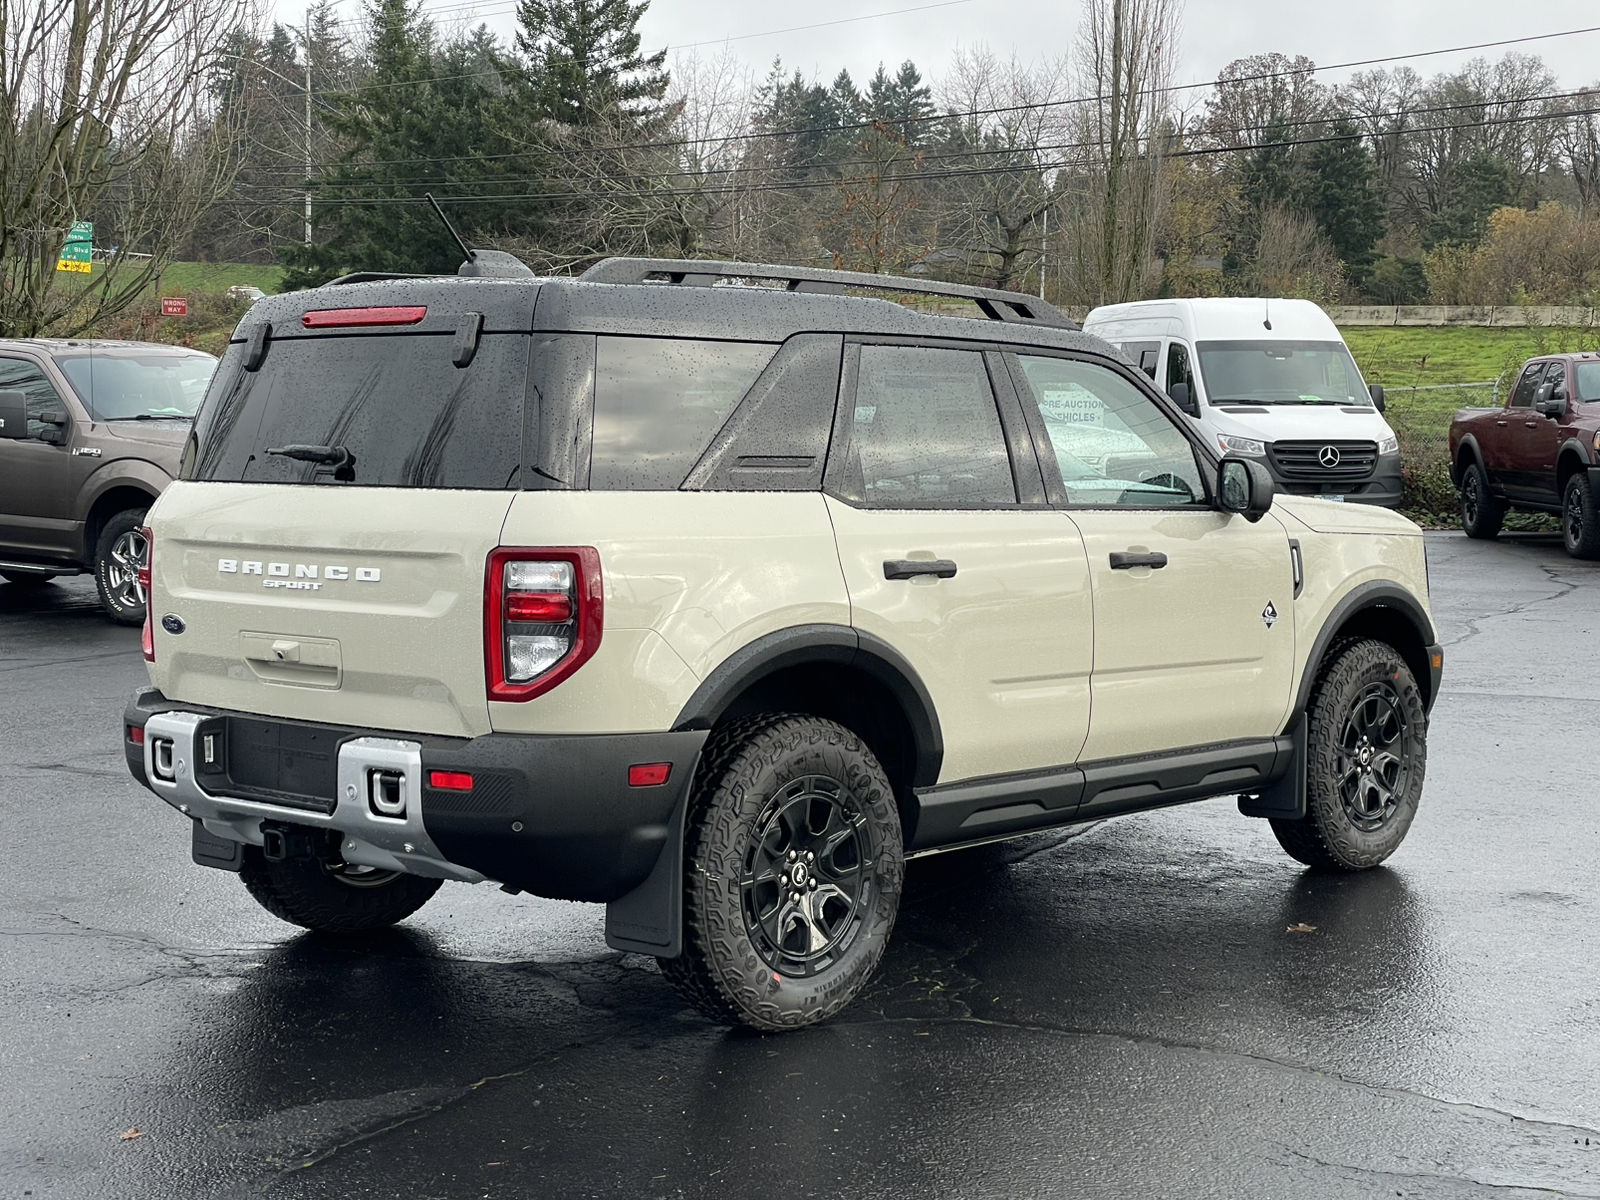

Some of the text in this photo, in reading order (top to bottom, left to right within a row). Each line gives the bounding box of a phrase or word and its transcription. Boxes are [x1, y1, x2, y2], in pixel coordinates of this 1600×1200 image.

[73, 246, 89, 254] Blvd
[1043, 400, 1104, 409] PRE-AUCTION
[1055, 412, 1096, 422] EHICLES
[218, 558, 381, 582] BRONCO
[262, 579, 323, 590] SPORT
[847, 762, 896, 917] GOODYEAR
